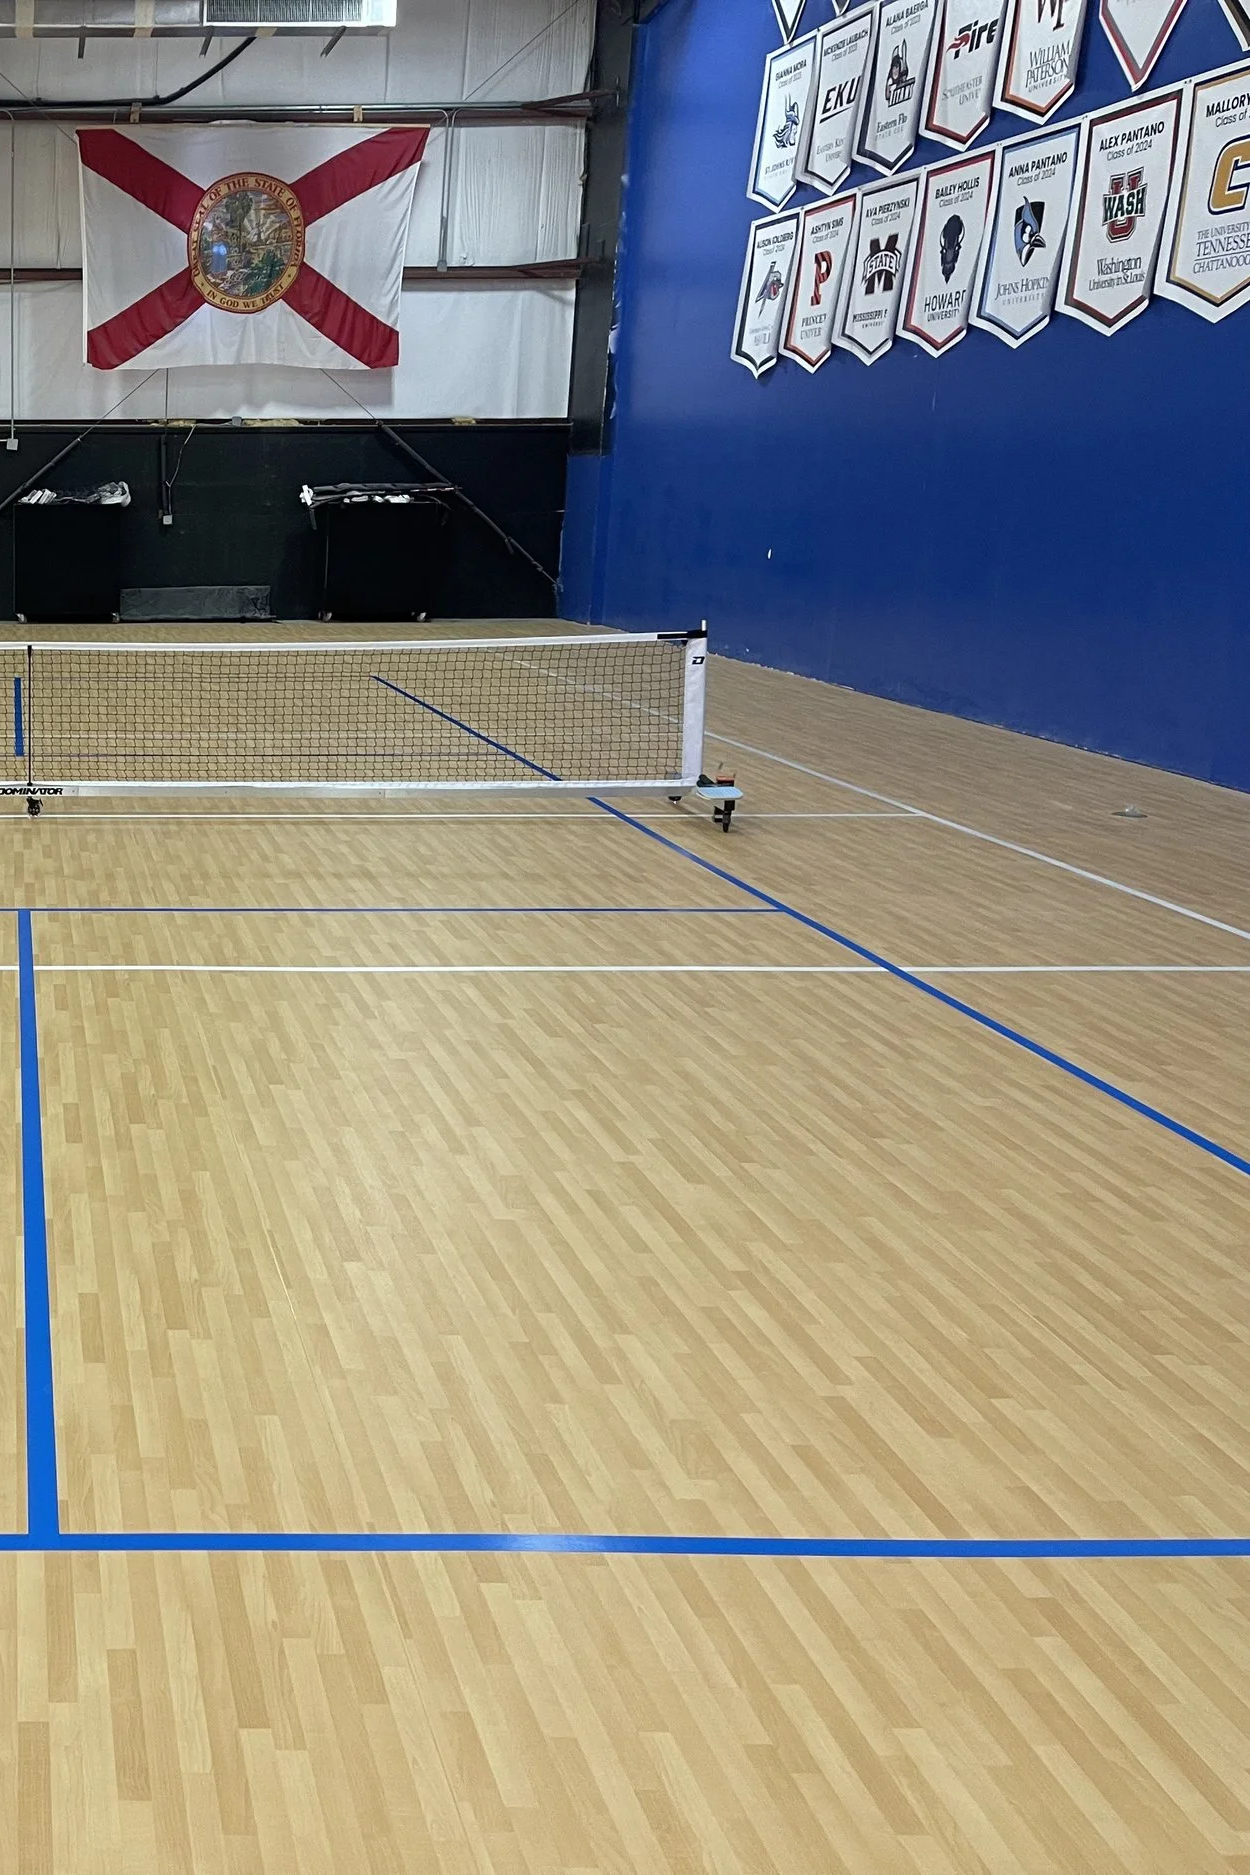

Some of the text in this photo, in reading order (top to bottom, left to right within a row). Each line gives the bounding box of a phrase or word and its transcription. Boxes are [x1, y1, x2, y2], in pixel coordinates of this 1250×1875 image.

[1030, 40, 1070, 67] WILLIAM
[1026, 58, 1069, 88] PATERSON
[822, 75, 861, 114] EKU
[1215, 108, 1248, 128] Class of
[1100, 121, 1165, 152] ALEX PANTANO
[1106, 148, 1125, 162] Class
[1134, 139, 1152, 154] 2024
[1008, 152, 1068, 178] ANNA PANTANO
[224, 178, 250, 192] THE
[254, 178, 286, 198] STATE
[935, 177, 980, 200] BAILEY HOLLIS
[1017, 174, 1032, 186] Class
[866, 206, 878, 218] AVA
[939, 196, 952, 208] Class
[1103, 184, 1147, 222] WASH
[832, 217, 844, 230] SIMS
[1198, 229, 1210, 240] THE
[868, 252, 895, 273] STATE
[1097, 257, 1142, 276] Washington
[810, 250, 833, 306] P
[206, 283, 284, 309] IN GOD WE TRUST
